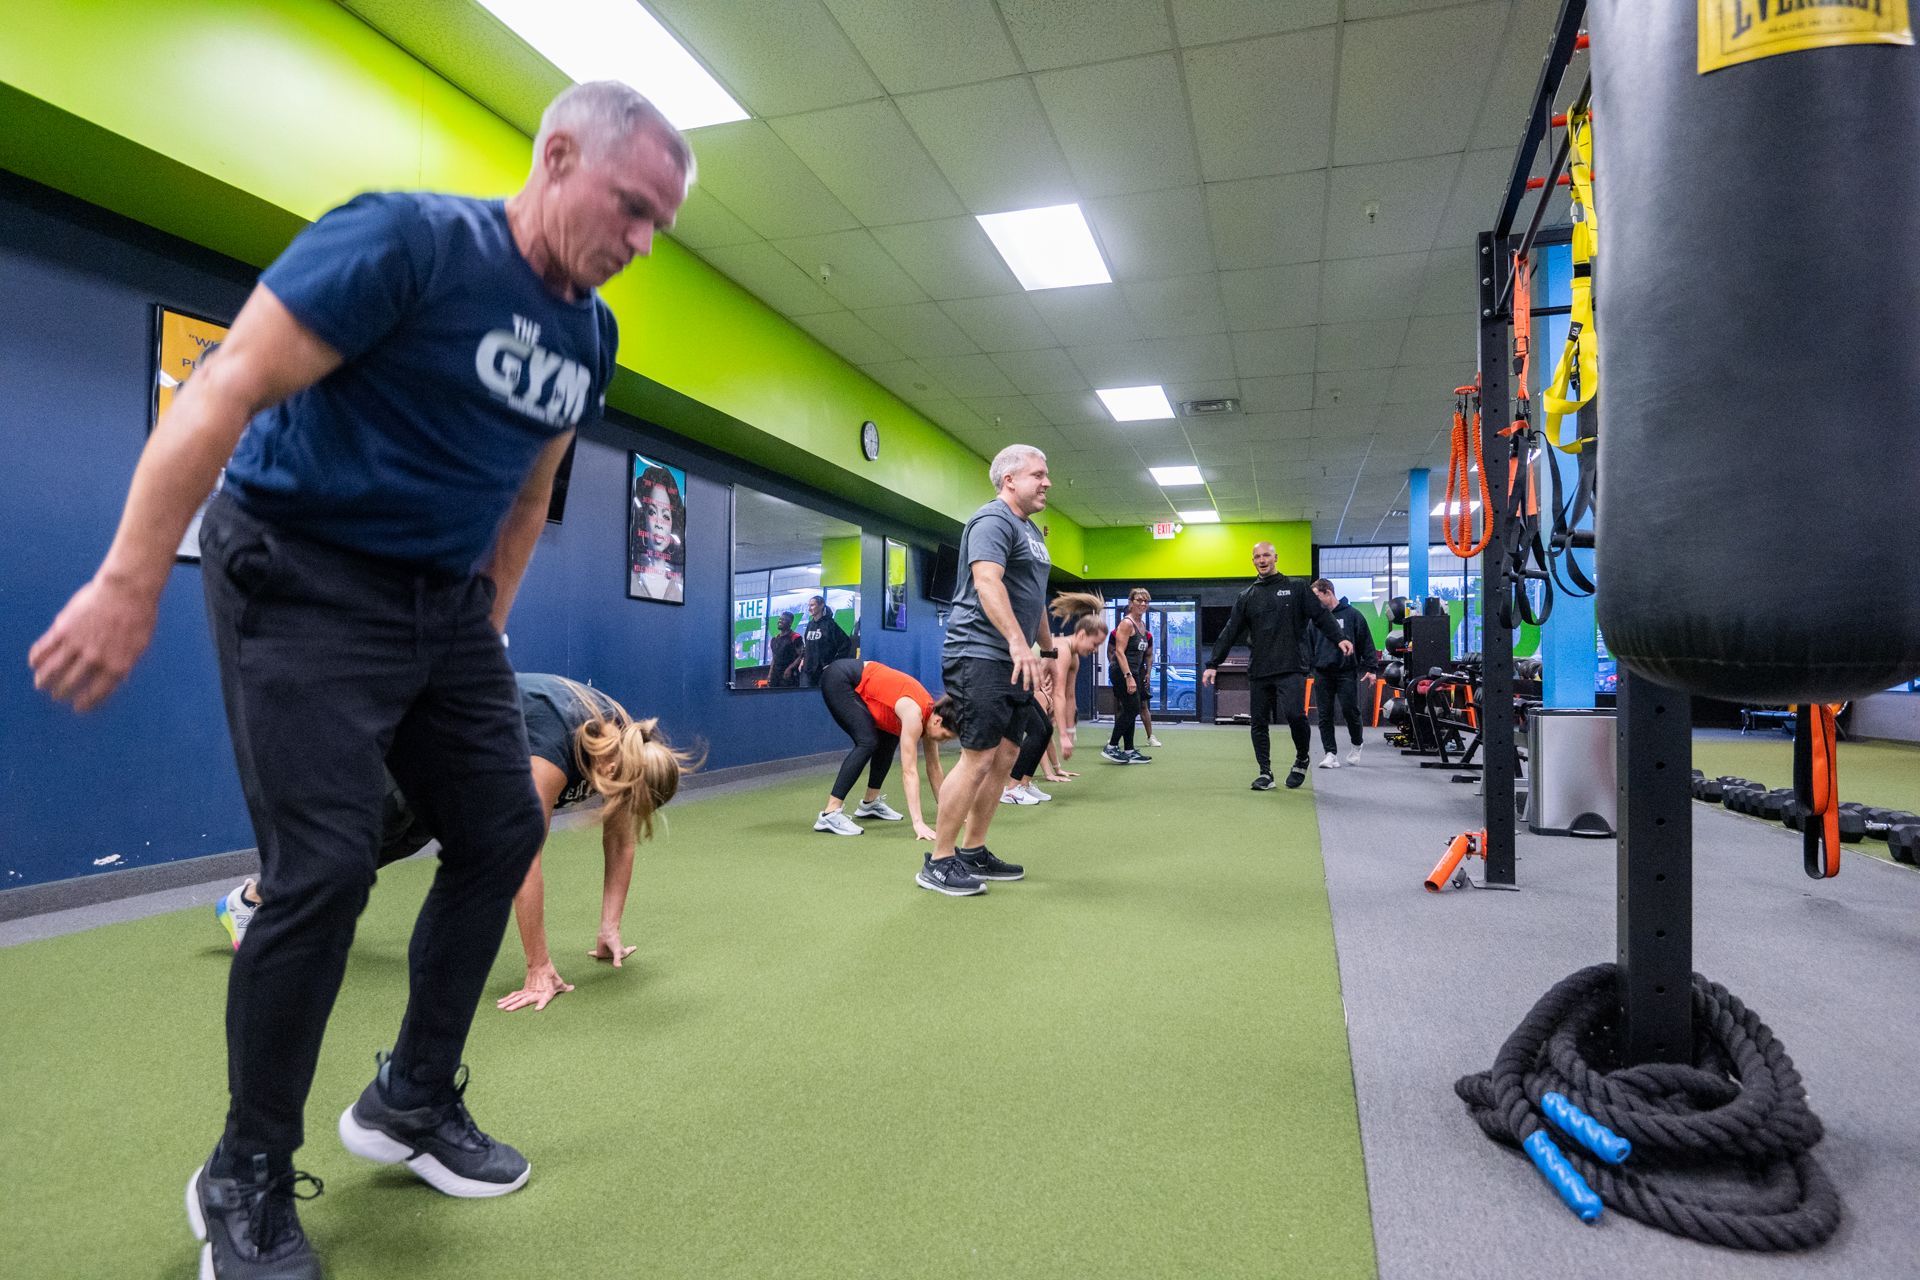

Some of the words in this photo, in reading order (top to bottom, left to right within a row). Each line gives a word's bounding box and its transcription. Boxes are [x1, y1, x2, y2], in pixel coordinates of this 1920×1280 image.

[512, 312, 541, 346] THE
[475, 327, 591, 425] GYM
[1157, 523, 1172, 535] EXIT
[738, 599, 763, 618] THE
